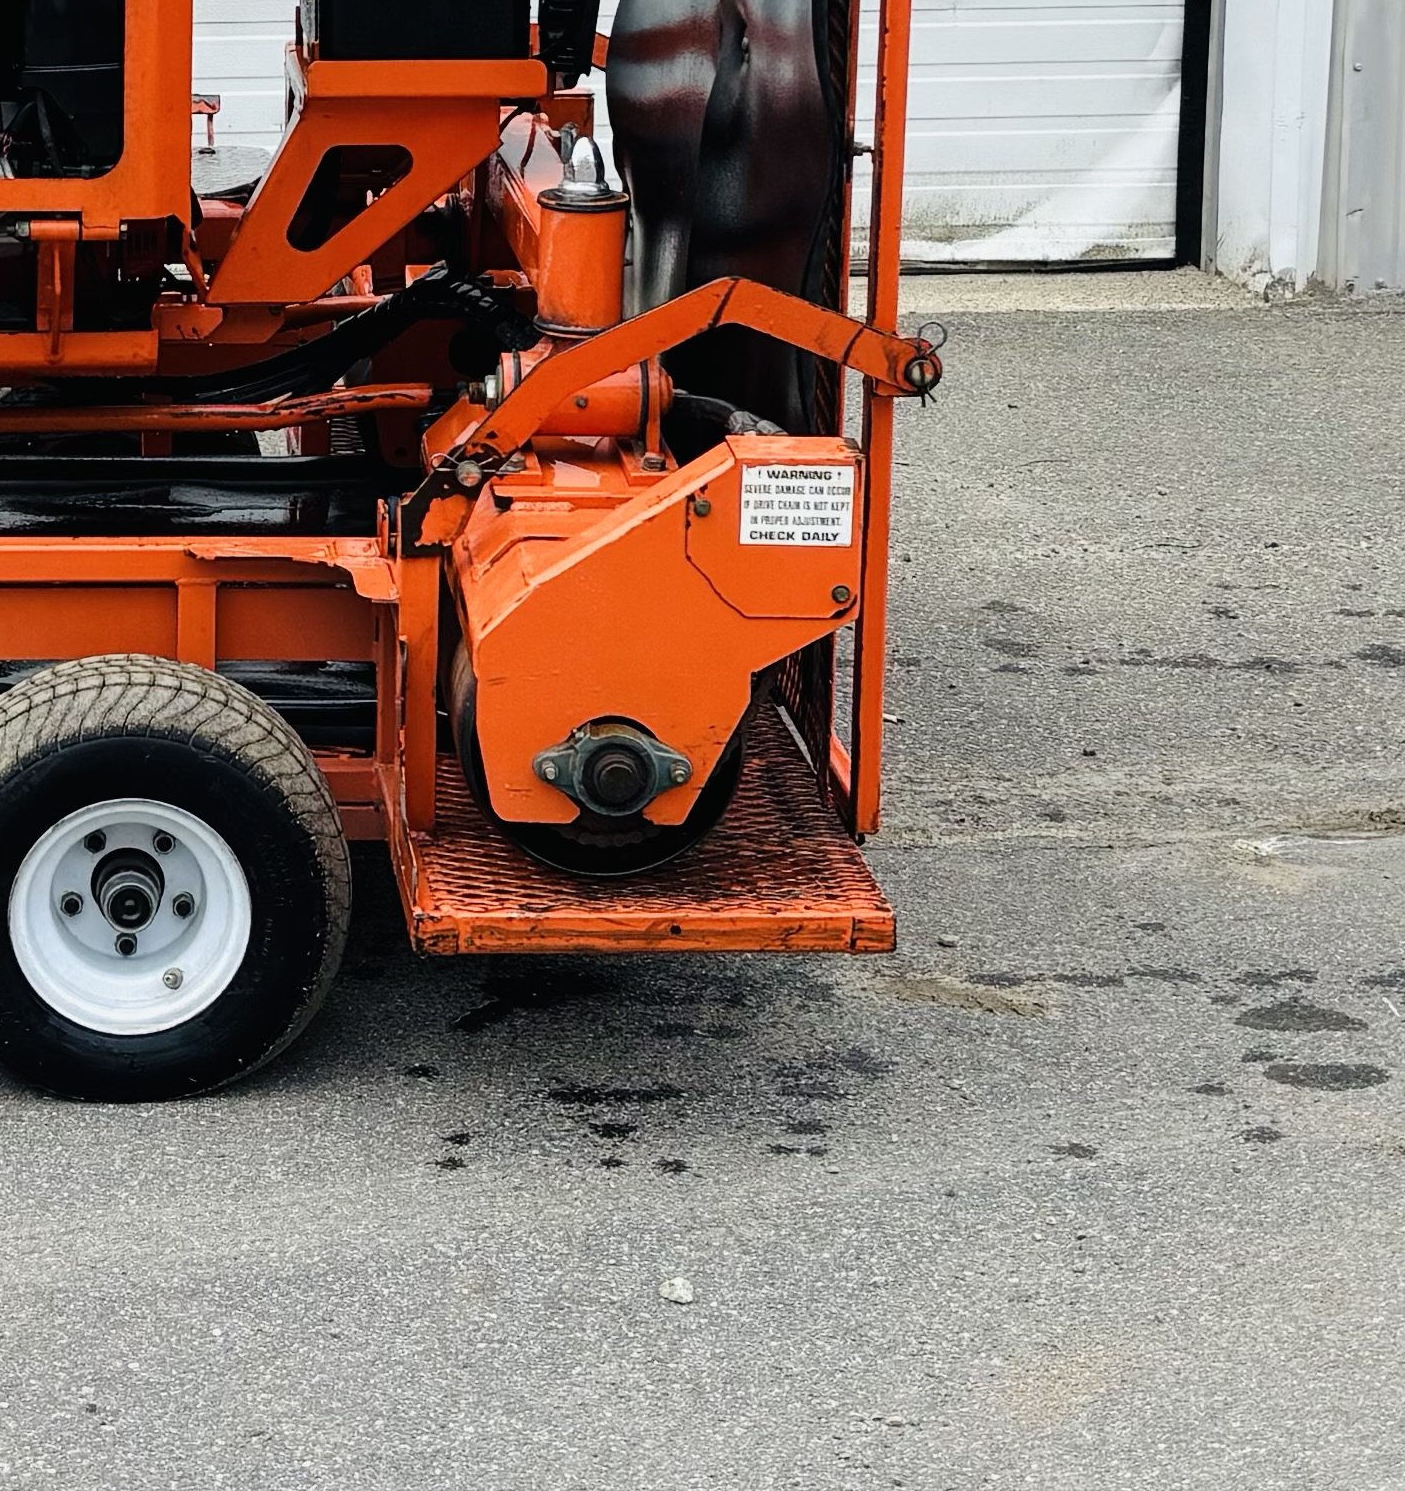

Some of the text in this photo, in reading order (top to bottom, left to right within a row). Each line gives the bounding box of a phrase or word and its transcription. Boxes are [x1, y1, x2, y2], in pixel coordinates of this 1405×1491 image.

[766, 470, 832, 480] WARNING
[744, 484, 851, 495] SEVERE DAMAGE CAN OCCUR
[743, 500, 850, 511] IF DRIVE CHAIN IS NOT KEPT
[750, 515, 758, 524] IN
[761, 515, 789, 525] PROPER
[749, 530, 839, 541] CHECK DAILY
